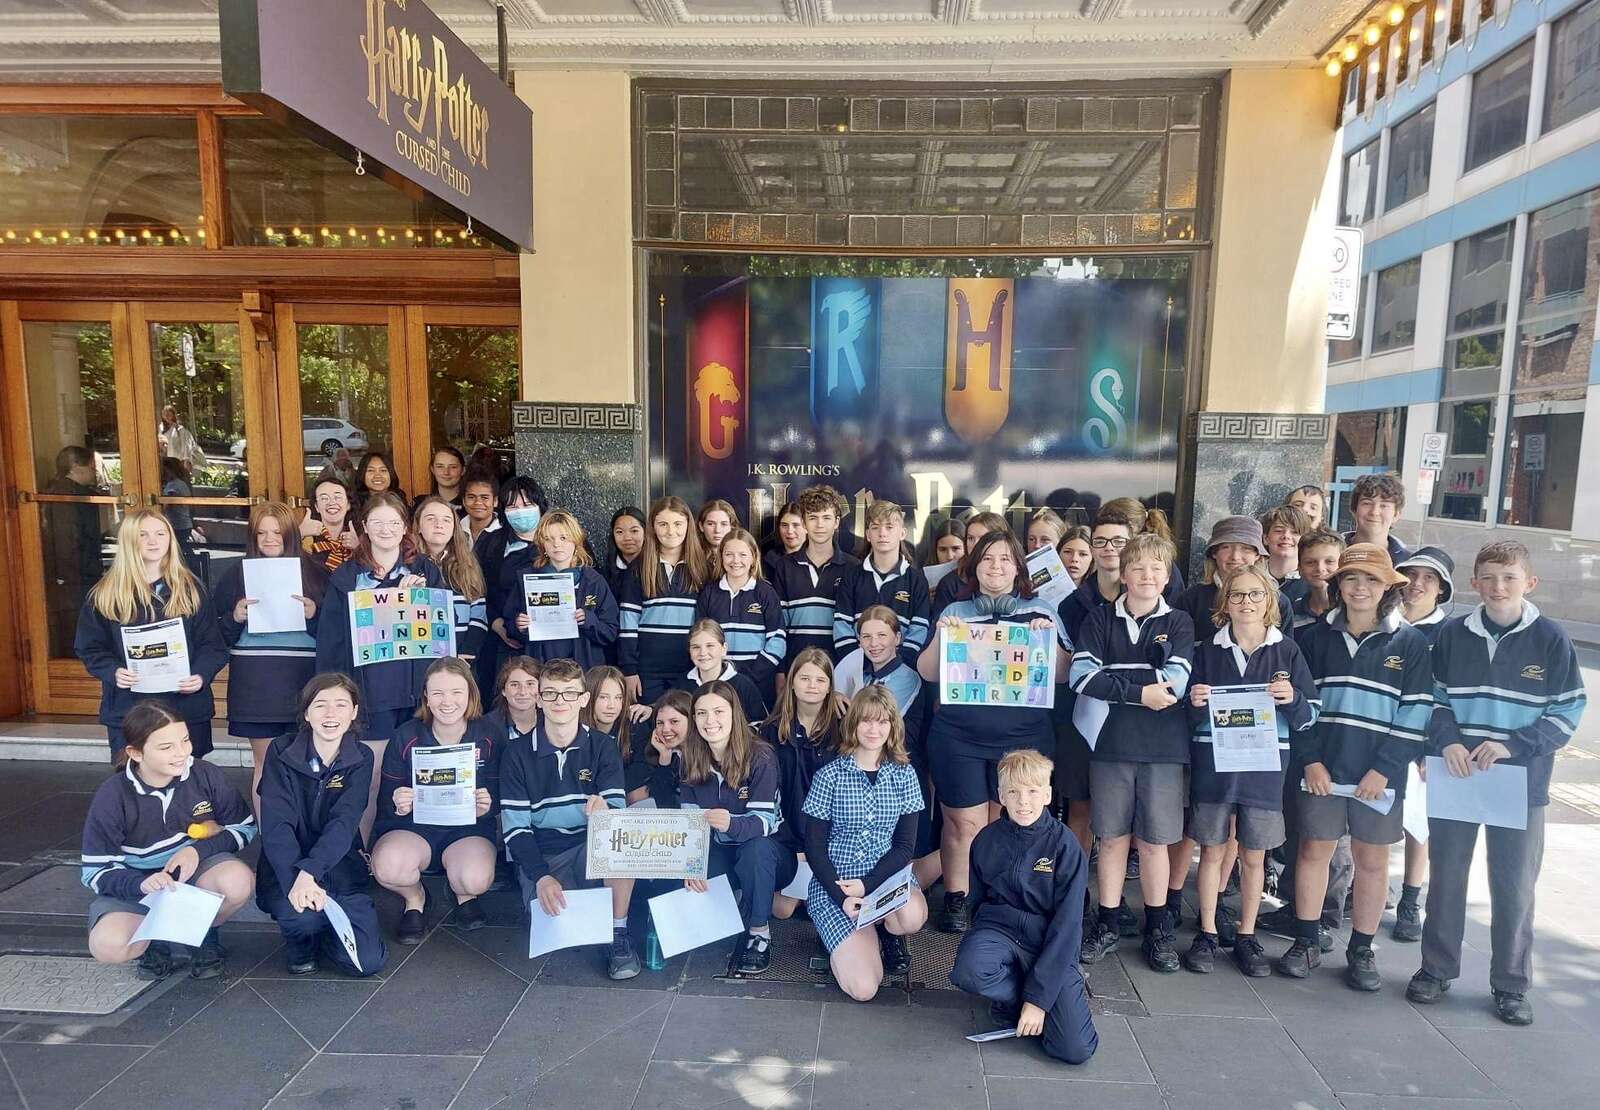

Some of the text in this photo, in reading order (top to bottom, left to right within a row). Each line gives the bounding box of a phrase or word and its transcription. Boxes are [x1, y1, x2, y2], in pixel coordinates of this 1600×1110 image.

[360, 0, 490, 170] Harry Potter
[395, 130, 471, 196] CURSED CHILD
[747, 463, 841, 476] J.K. ROWLING'S
[609, 828, 648, 852] Harry
